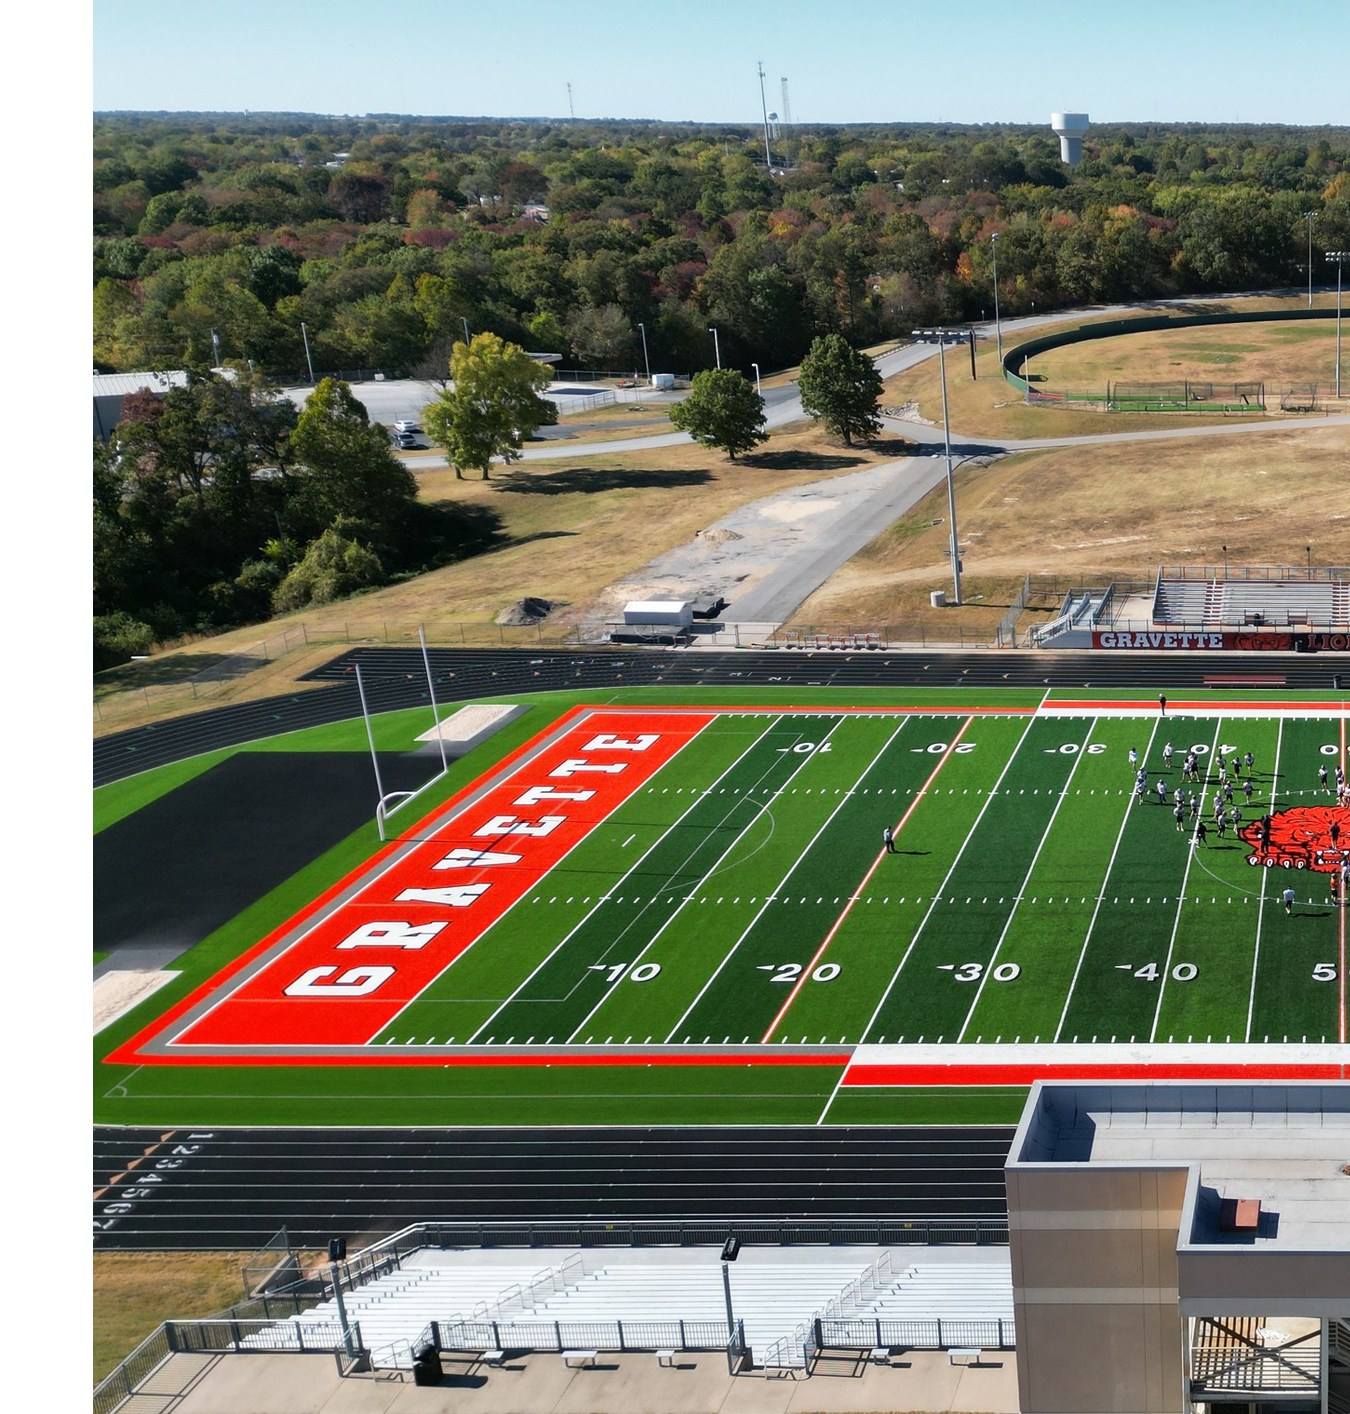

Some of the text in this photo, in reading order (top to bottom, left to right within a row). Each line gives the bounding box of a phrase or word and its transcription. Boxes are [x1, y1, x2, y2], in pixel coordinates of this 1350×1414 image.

[1100, 633, 1223, 648] GRAVETTE
[282, 733, 662, 998] GRAVETTE
[606, 963, 661, 982] 10
[769, 963, 842, 982] 20
[954, 963, 1021, 982] 30
[1134, 963, 1199, 982] 40
